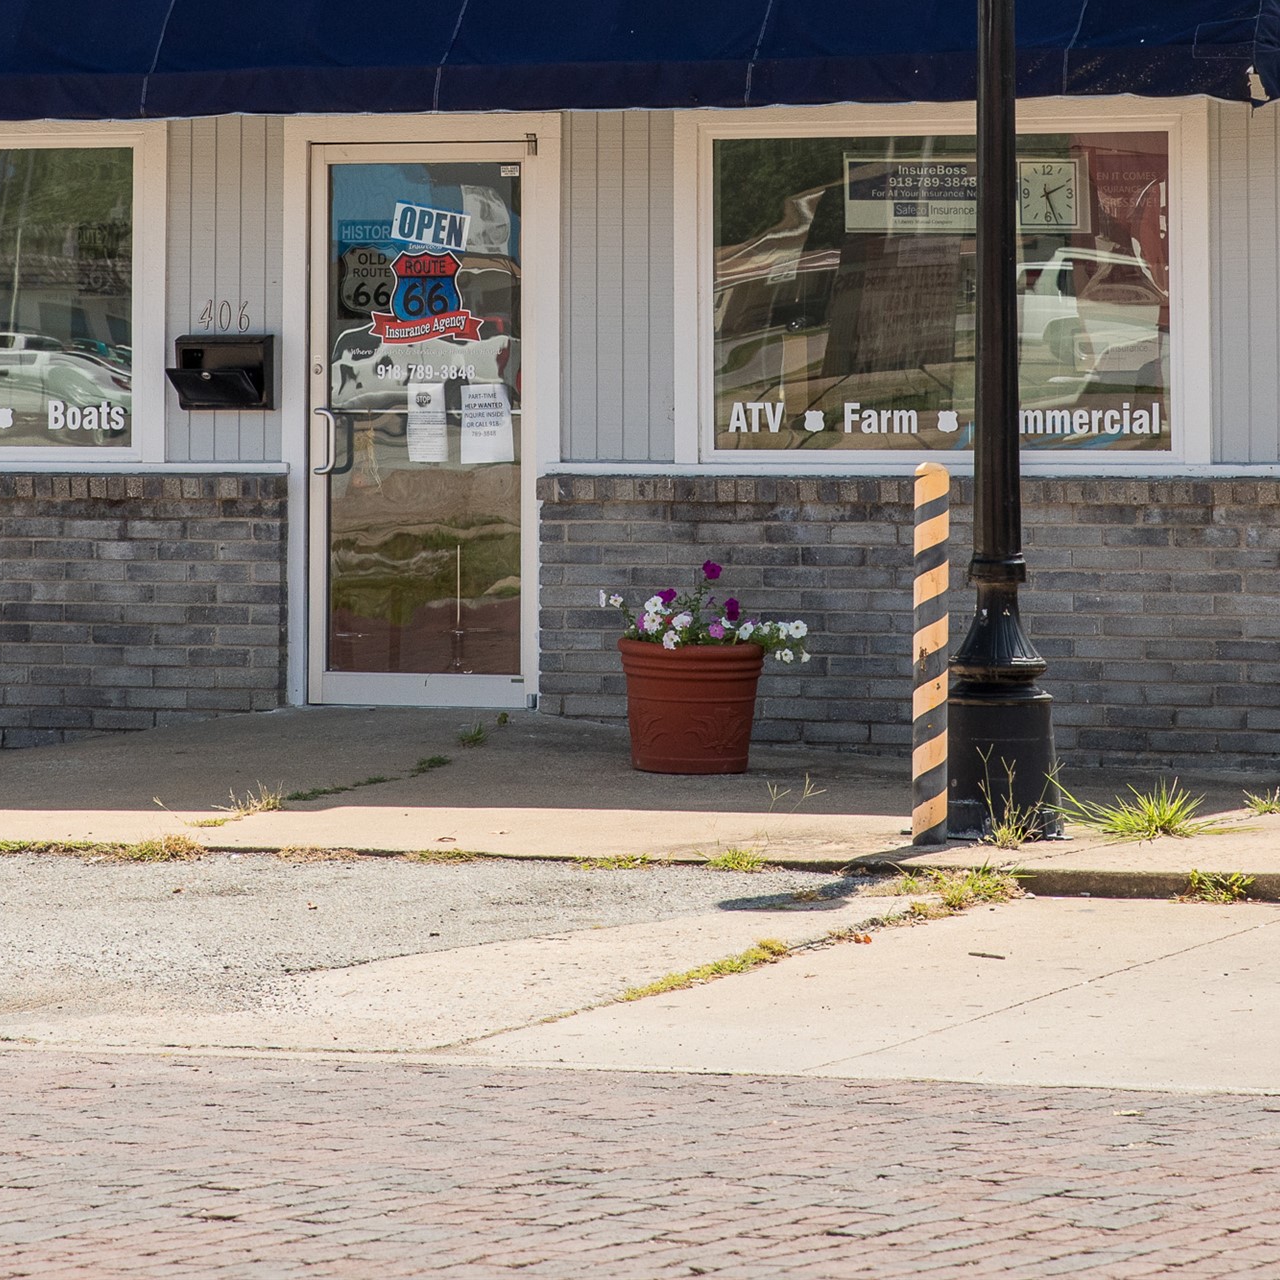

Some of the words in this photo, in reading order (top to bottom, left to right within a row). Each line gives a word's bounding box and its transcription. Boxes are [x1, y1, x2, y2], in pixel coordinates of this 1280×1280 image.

[898, 165, 968, 175] InsureBoss
[1041, 164, 1053, 176] 12
[1096, 171, 1109, 181] EN
[1122, 171, 1156, 181] COMES
[889, 177, 977, 187] 918-789-3848
[871, 189, 885, 197] For
[887, 189, 898, 197] All
[900, 189, 919, 198] Your
[921, 189, 964, 197] Insurance
[1022, 187, 1030, 199] 9
[1066, 188, 1073, 199] 3
[1045, 211, 1052, 222] 6
[342, 225, 391, 240] HISTOR
[398, 206, 466, 248] OPEN
[357, 252, 387, 265] OLD
[353, 268, 391, 278] ROUTE
[405, 260, 446, 274] ROUTE
[353, 282, 390, 307] 66
[403, 282, 448, 316] 66
[198, 299, 250, 333] 406
[385, 322, 430, 339] Insurance
[432, 315, 466, 333] Agency
[377, 364, 476, 380] 918-789-3848
[416, 394, 431, 403] STOP
[47, 399, 125, 431] Boats
[728, 402, 784, 433] ATV
[844, 402, 918, 434] Farm
[1018, 402, 1160, 435] mmercial
